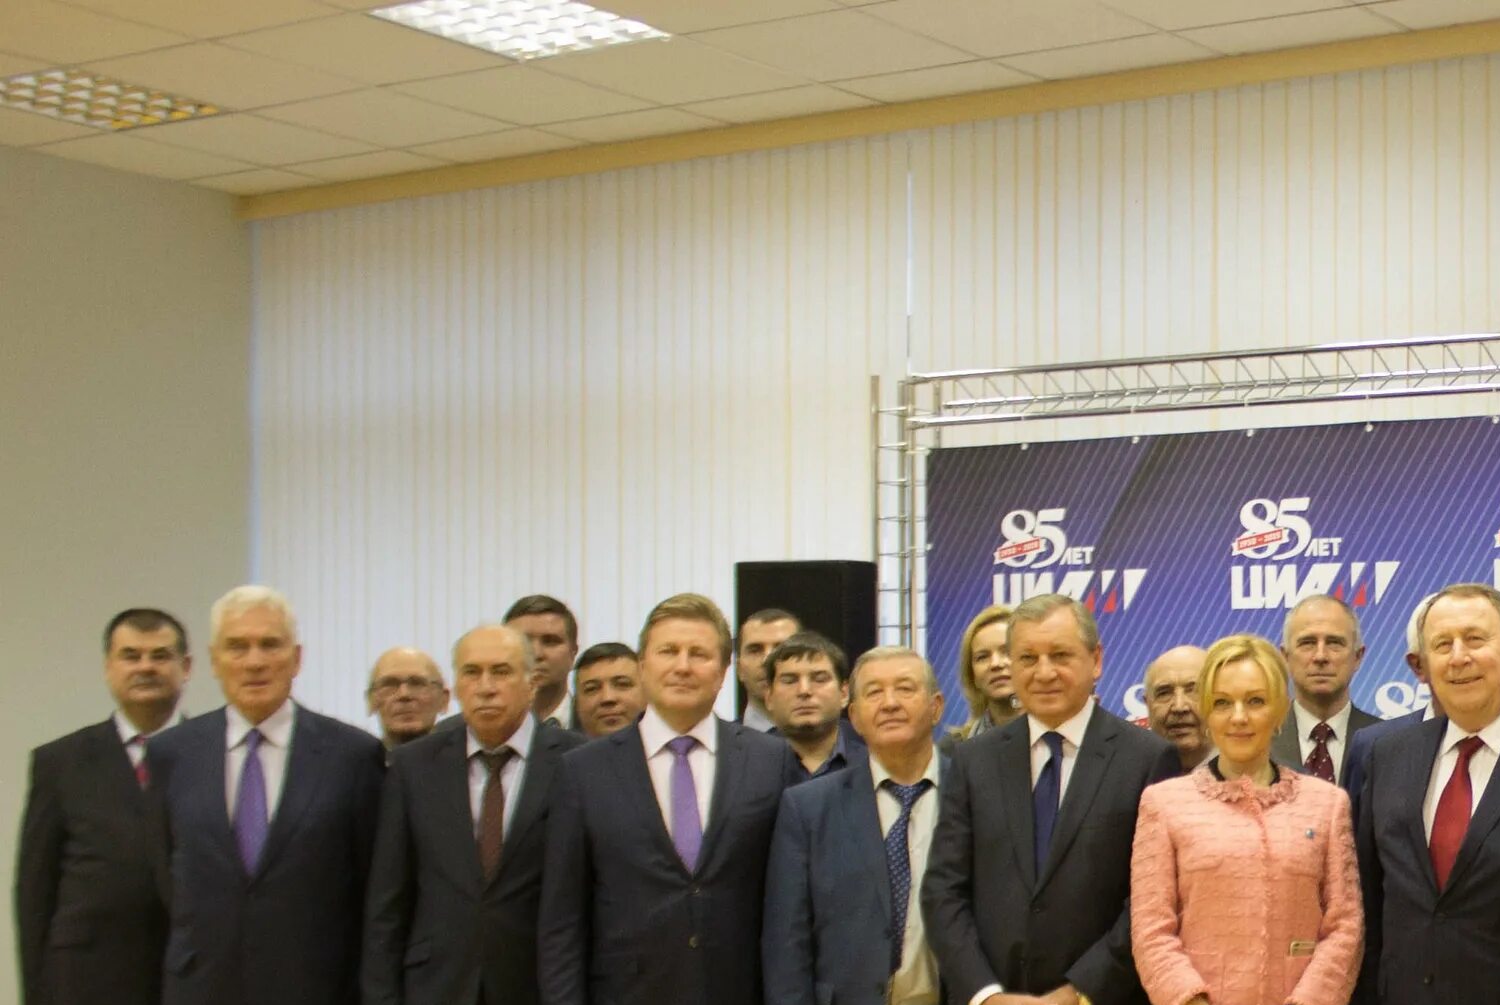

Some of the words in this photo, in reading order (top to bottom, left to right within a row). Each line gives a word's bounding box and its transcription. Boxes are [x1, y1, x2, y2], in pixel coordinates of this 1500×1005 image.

[1001, 508, 1067, 568] 85
[1059, 546, 1095, 565] ЛЕТ
[1240, 497, 1312, 560] 85
[1304, 537, 1343, 557] ЛЕТ
